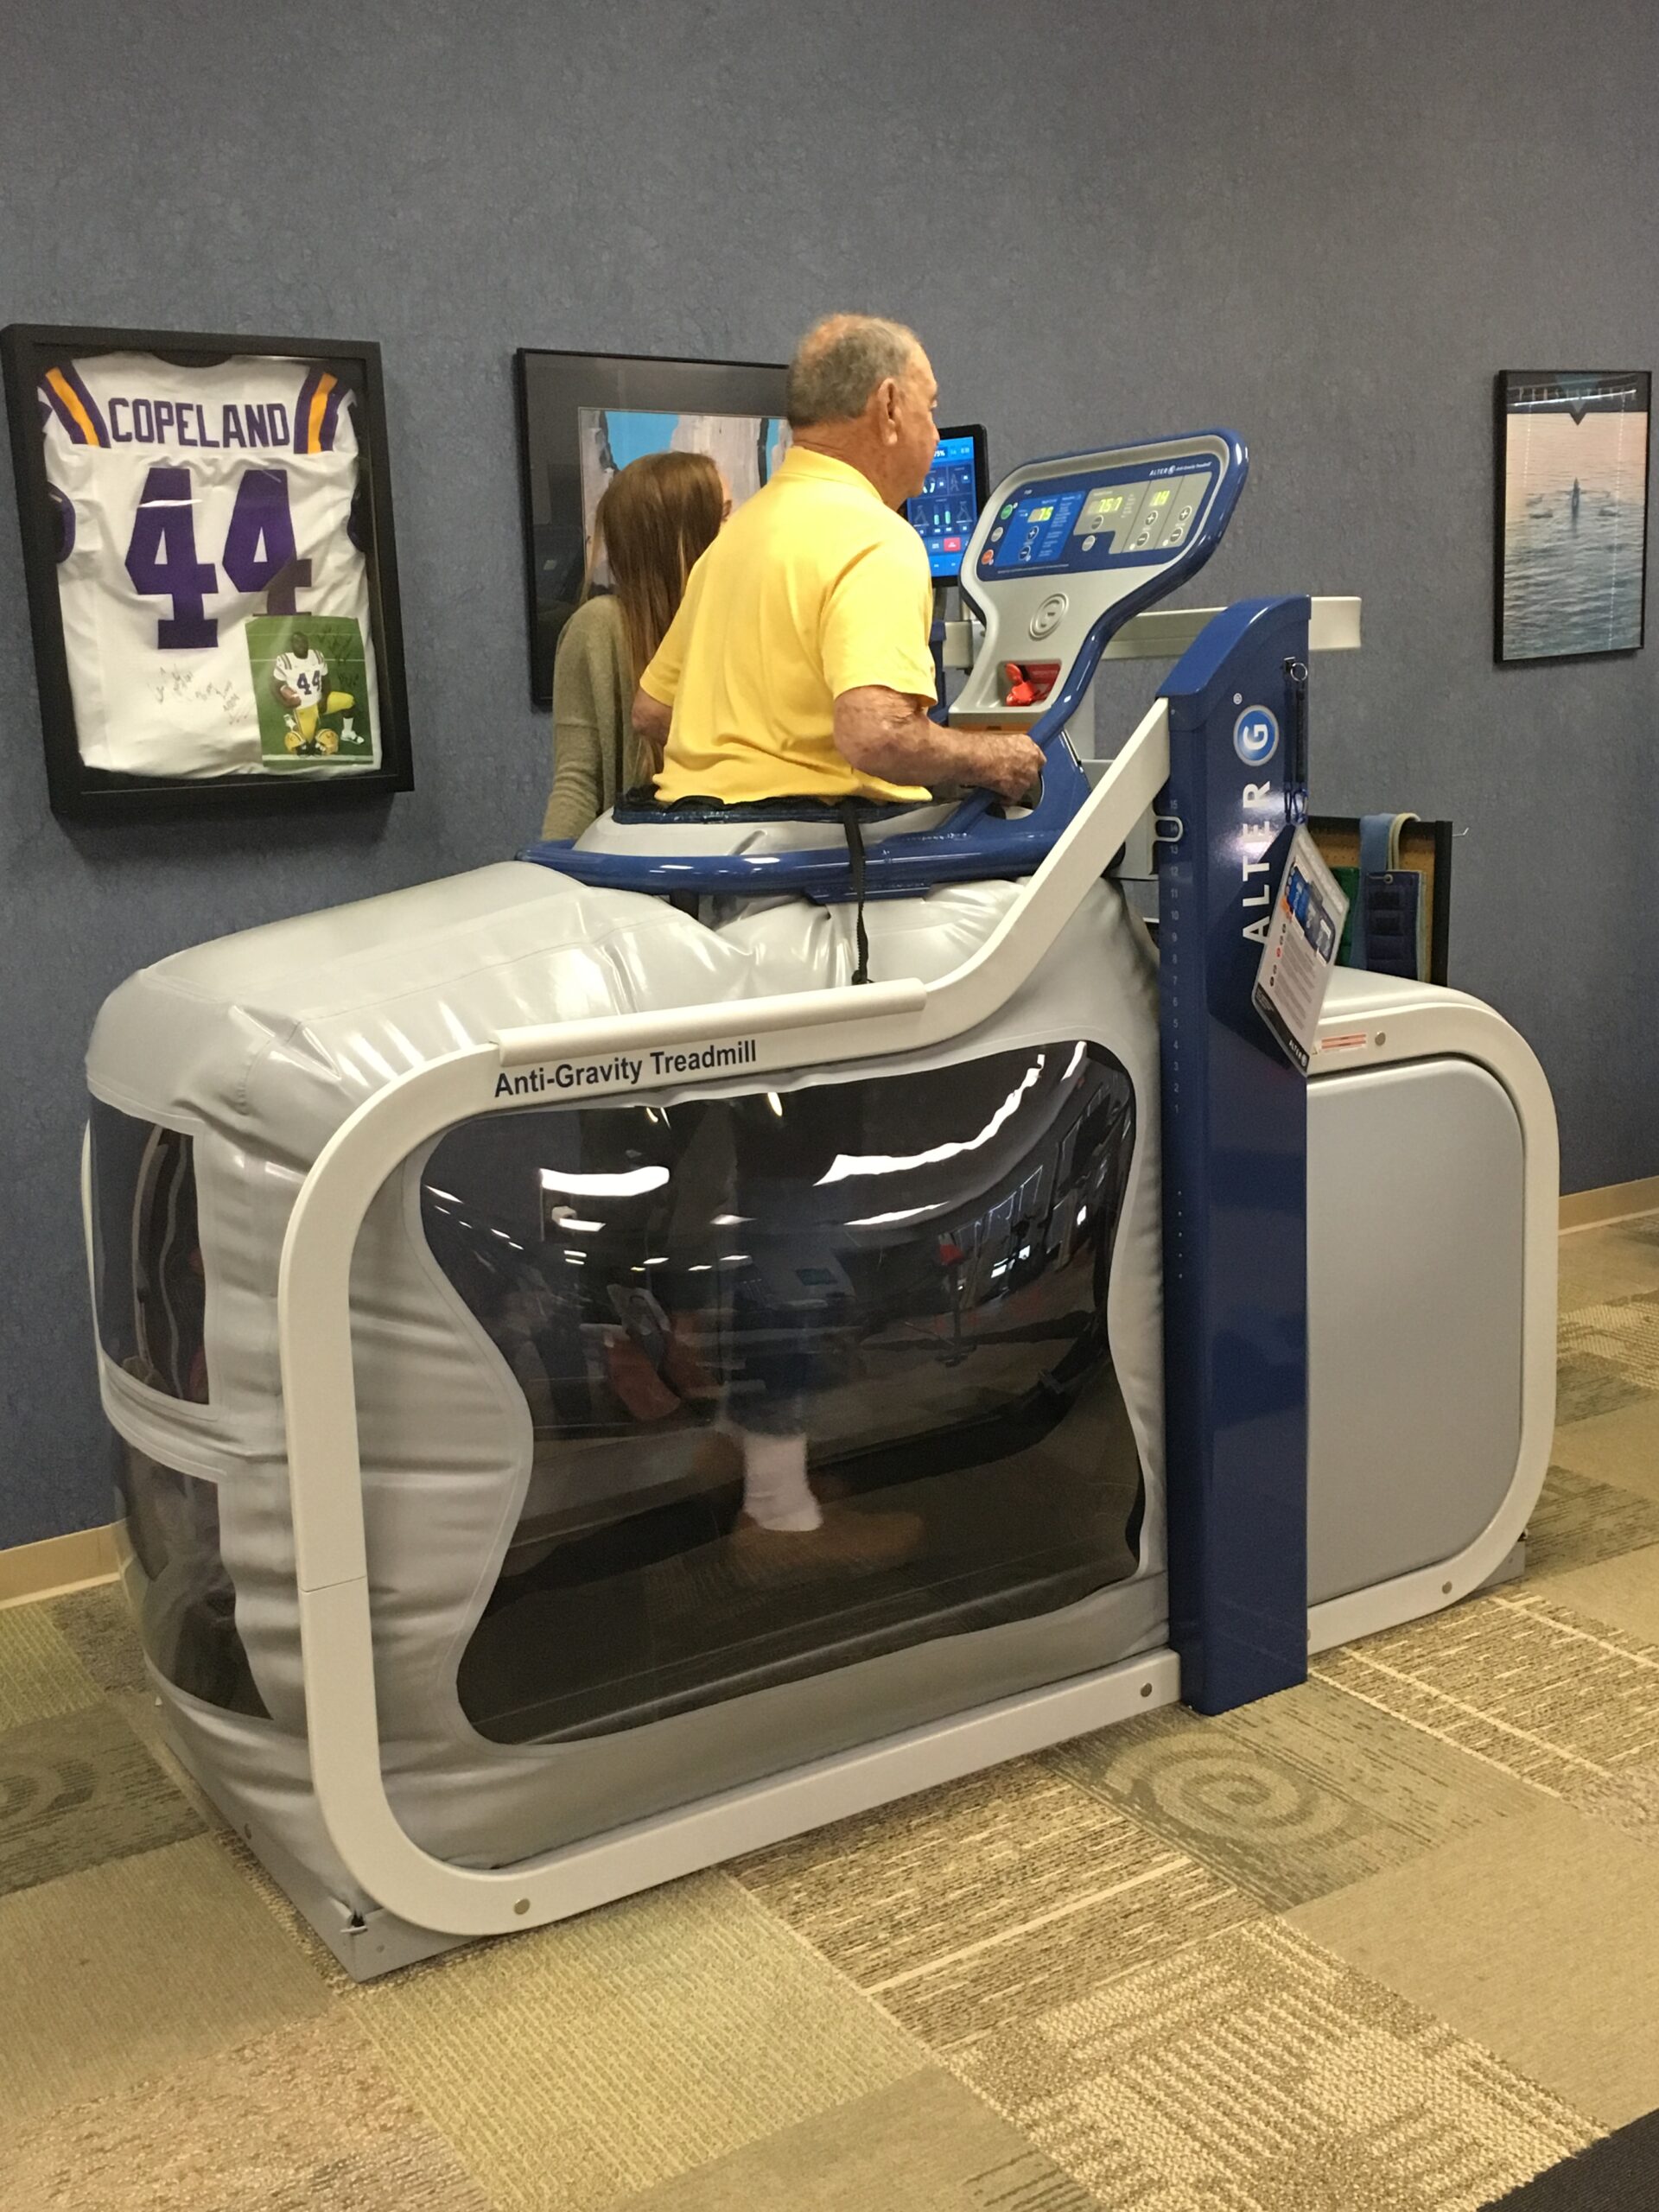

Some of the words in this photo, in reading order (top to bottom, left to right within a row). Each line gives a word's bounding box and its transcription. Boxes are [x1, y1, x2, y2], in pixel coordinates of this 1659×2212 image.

[108, 397, 290, 448] COPELAND
[124, 467, 312, 650] 44
[297, 670, 321, 696] 44
[1243, 723, 1268, 750] G
[1170, 799, 1179, 810] 15
[1171, 844, 1179, 855] 13
[1243, 781, 1270, 944] ALTER
[1171, 866, 1179, 877] 12
[1171, 887, 1179, 899] 11
[1171, 909, 1179, 920] 10
[494, 1057, 643, 1097] Anti-Gravity
[649, 1039, 758, 1075] Treadmill
